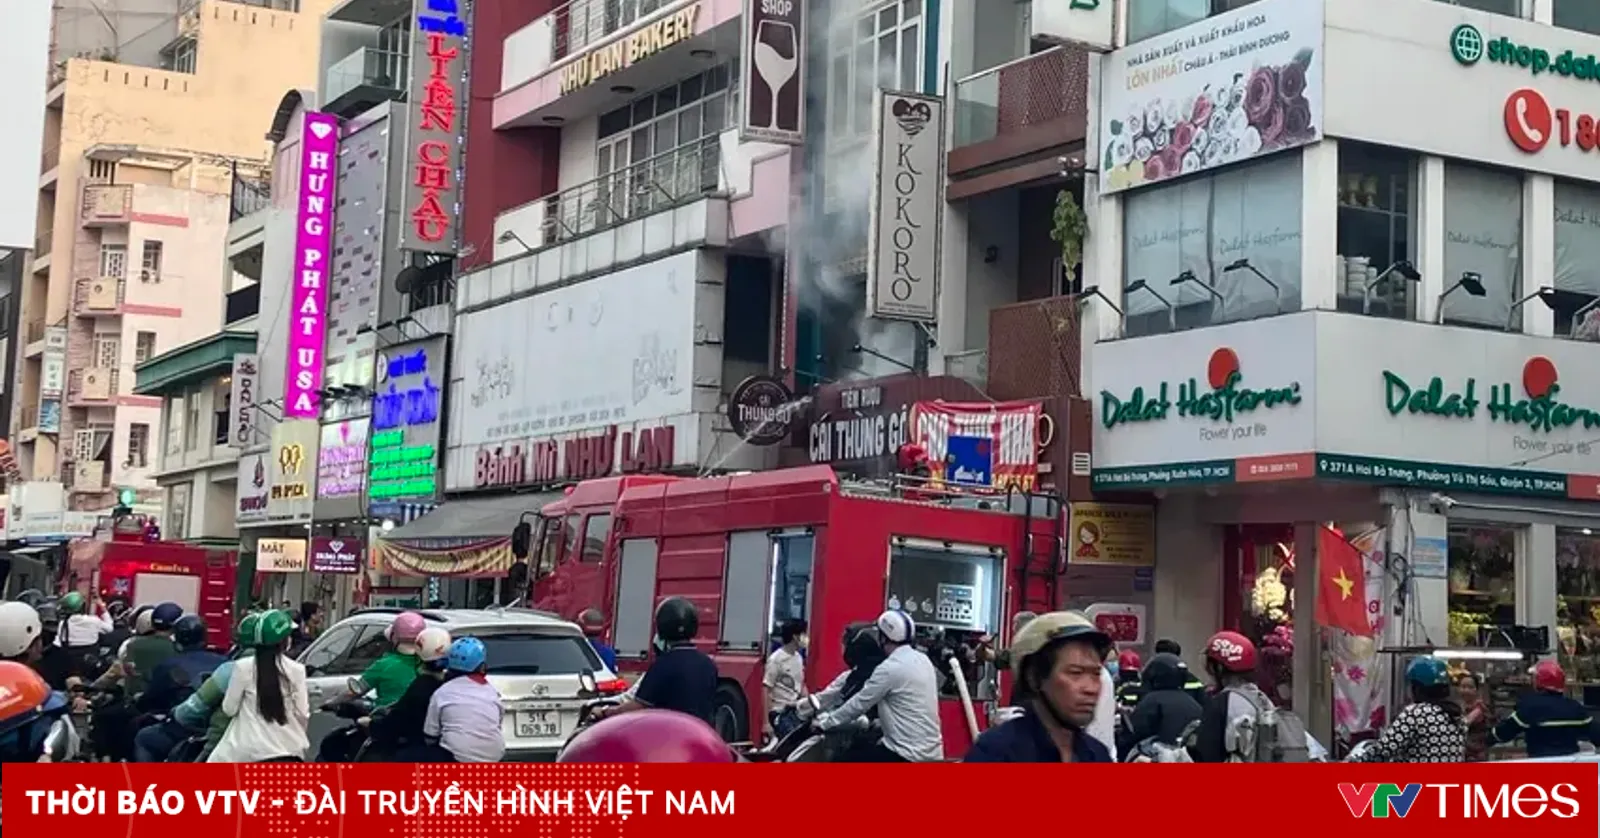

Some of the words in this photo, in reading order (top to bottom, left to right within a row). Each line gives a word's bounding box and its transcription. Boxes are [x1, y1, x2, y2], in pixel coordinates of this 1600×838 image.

[761, 0, 792, 16] SHOP
[1246, 14, 1266, 30] HOA
[559, 52, 591, 95] NHƯ
[588, 42, 625, 84] LAN
[625, 4, 701, 66] BAKERY
[1259, 30, 1290, 50] DƯƠNG
[420, 34, 457, 133] LIÊN
[1555, 109, 1600, 151] 18
[305, 151, 329, 235] HƯNG
[411, 140, 451, 242] CHÂU
[891, 142, 922, 302] KOKORO
[300, 249, 322, 335] PHÁT
[294, 347, 316, 411] USA
[1100, 380, 1171, 429] Dalat
[1176, 370, 1293, 423] Hasfarm
[1382, 370, 1479, 418] Dalat
[474, 440, 525, 488] Bánh
[532, 438, 559, 482] Mì
[565, 424, 618, 479] NHƯ
[621, 424, 676, 473] LAN
[810, 411, 832, 463] CÁI
[836, 410, 884, 460] THÙNG
[1231, 425, 1252, 441] your
[1330, 462, 1354, 474] 371A
[1355, 464, 1372, 475] Hai
[1417, 469, 1451, 485] Phường
[1500, 475, 1524, 490] Quận
